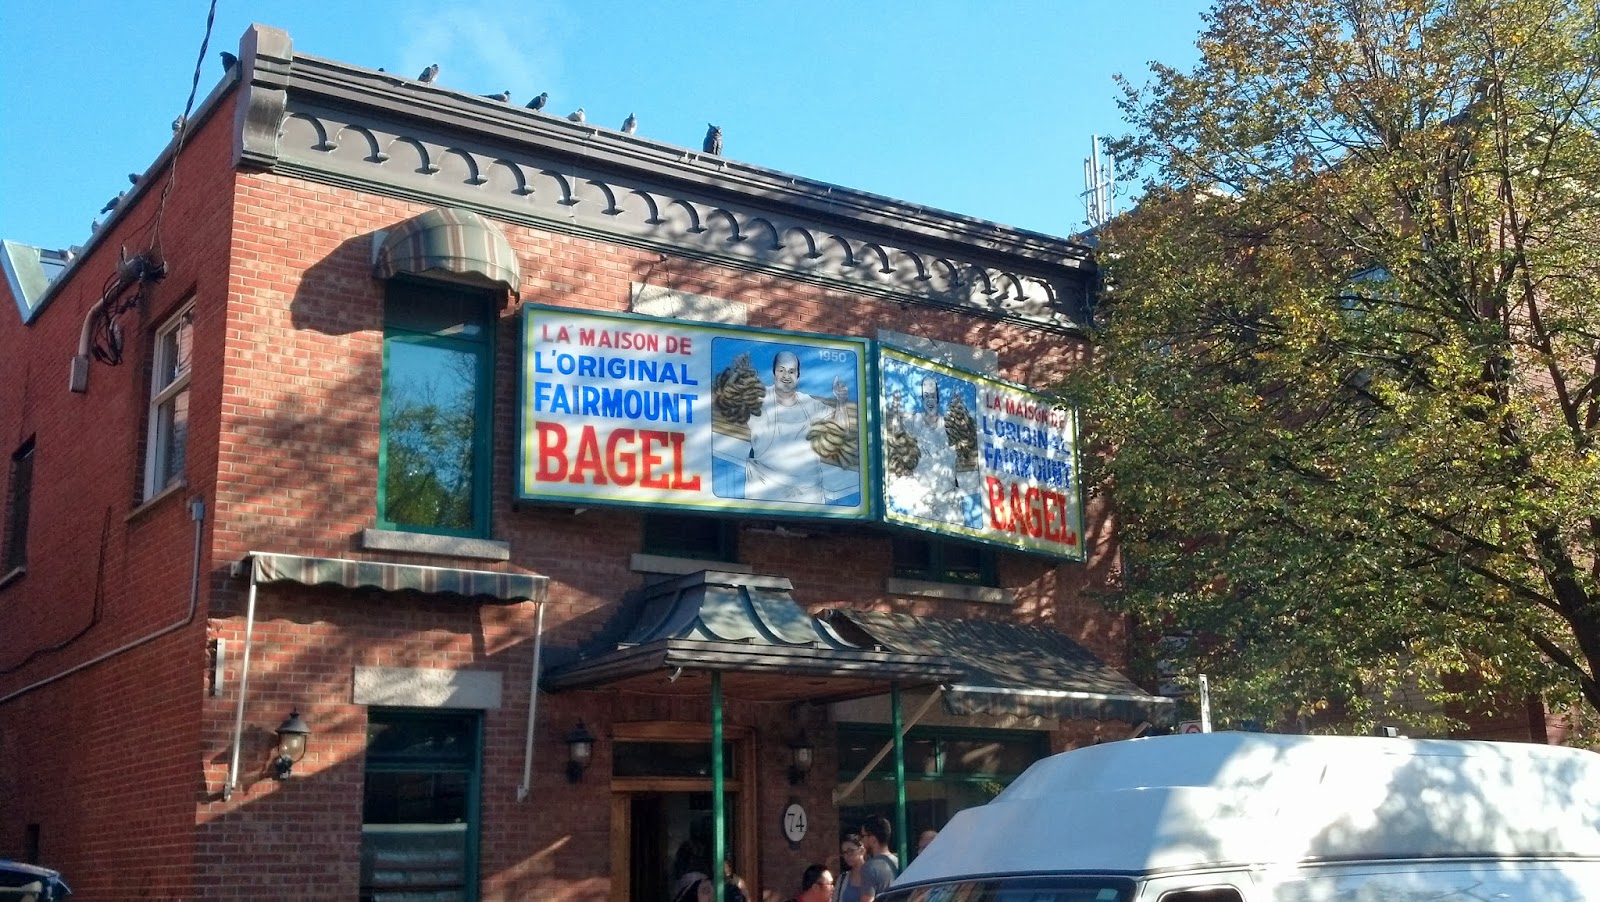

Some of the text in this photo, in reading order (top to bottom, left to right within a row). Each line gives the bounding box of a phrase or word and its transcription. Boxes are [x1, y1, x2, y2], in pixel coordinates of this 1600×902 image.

[542, 324, 692, 355] LA MAISON DE
[818, 350, 847, 363] 1950
[534, 350, 699, 386] L'ORIGINAL
[534, 381, 699, 424] FAIRMOUNT
[986, 392, 1002, 412] LA
[1005, 398, 1048, 424] MAISON
[535, 421, 701, 491] BAGEL
[985, 475, 1077, 546] BAGEL
[787, 812, 805, 833] 74
